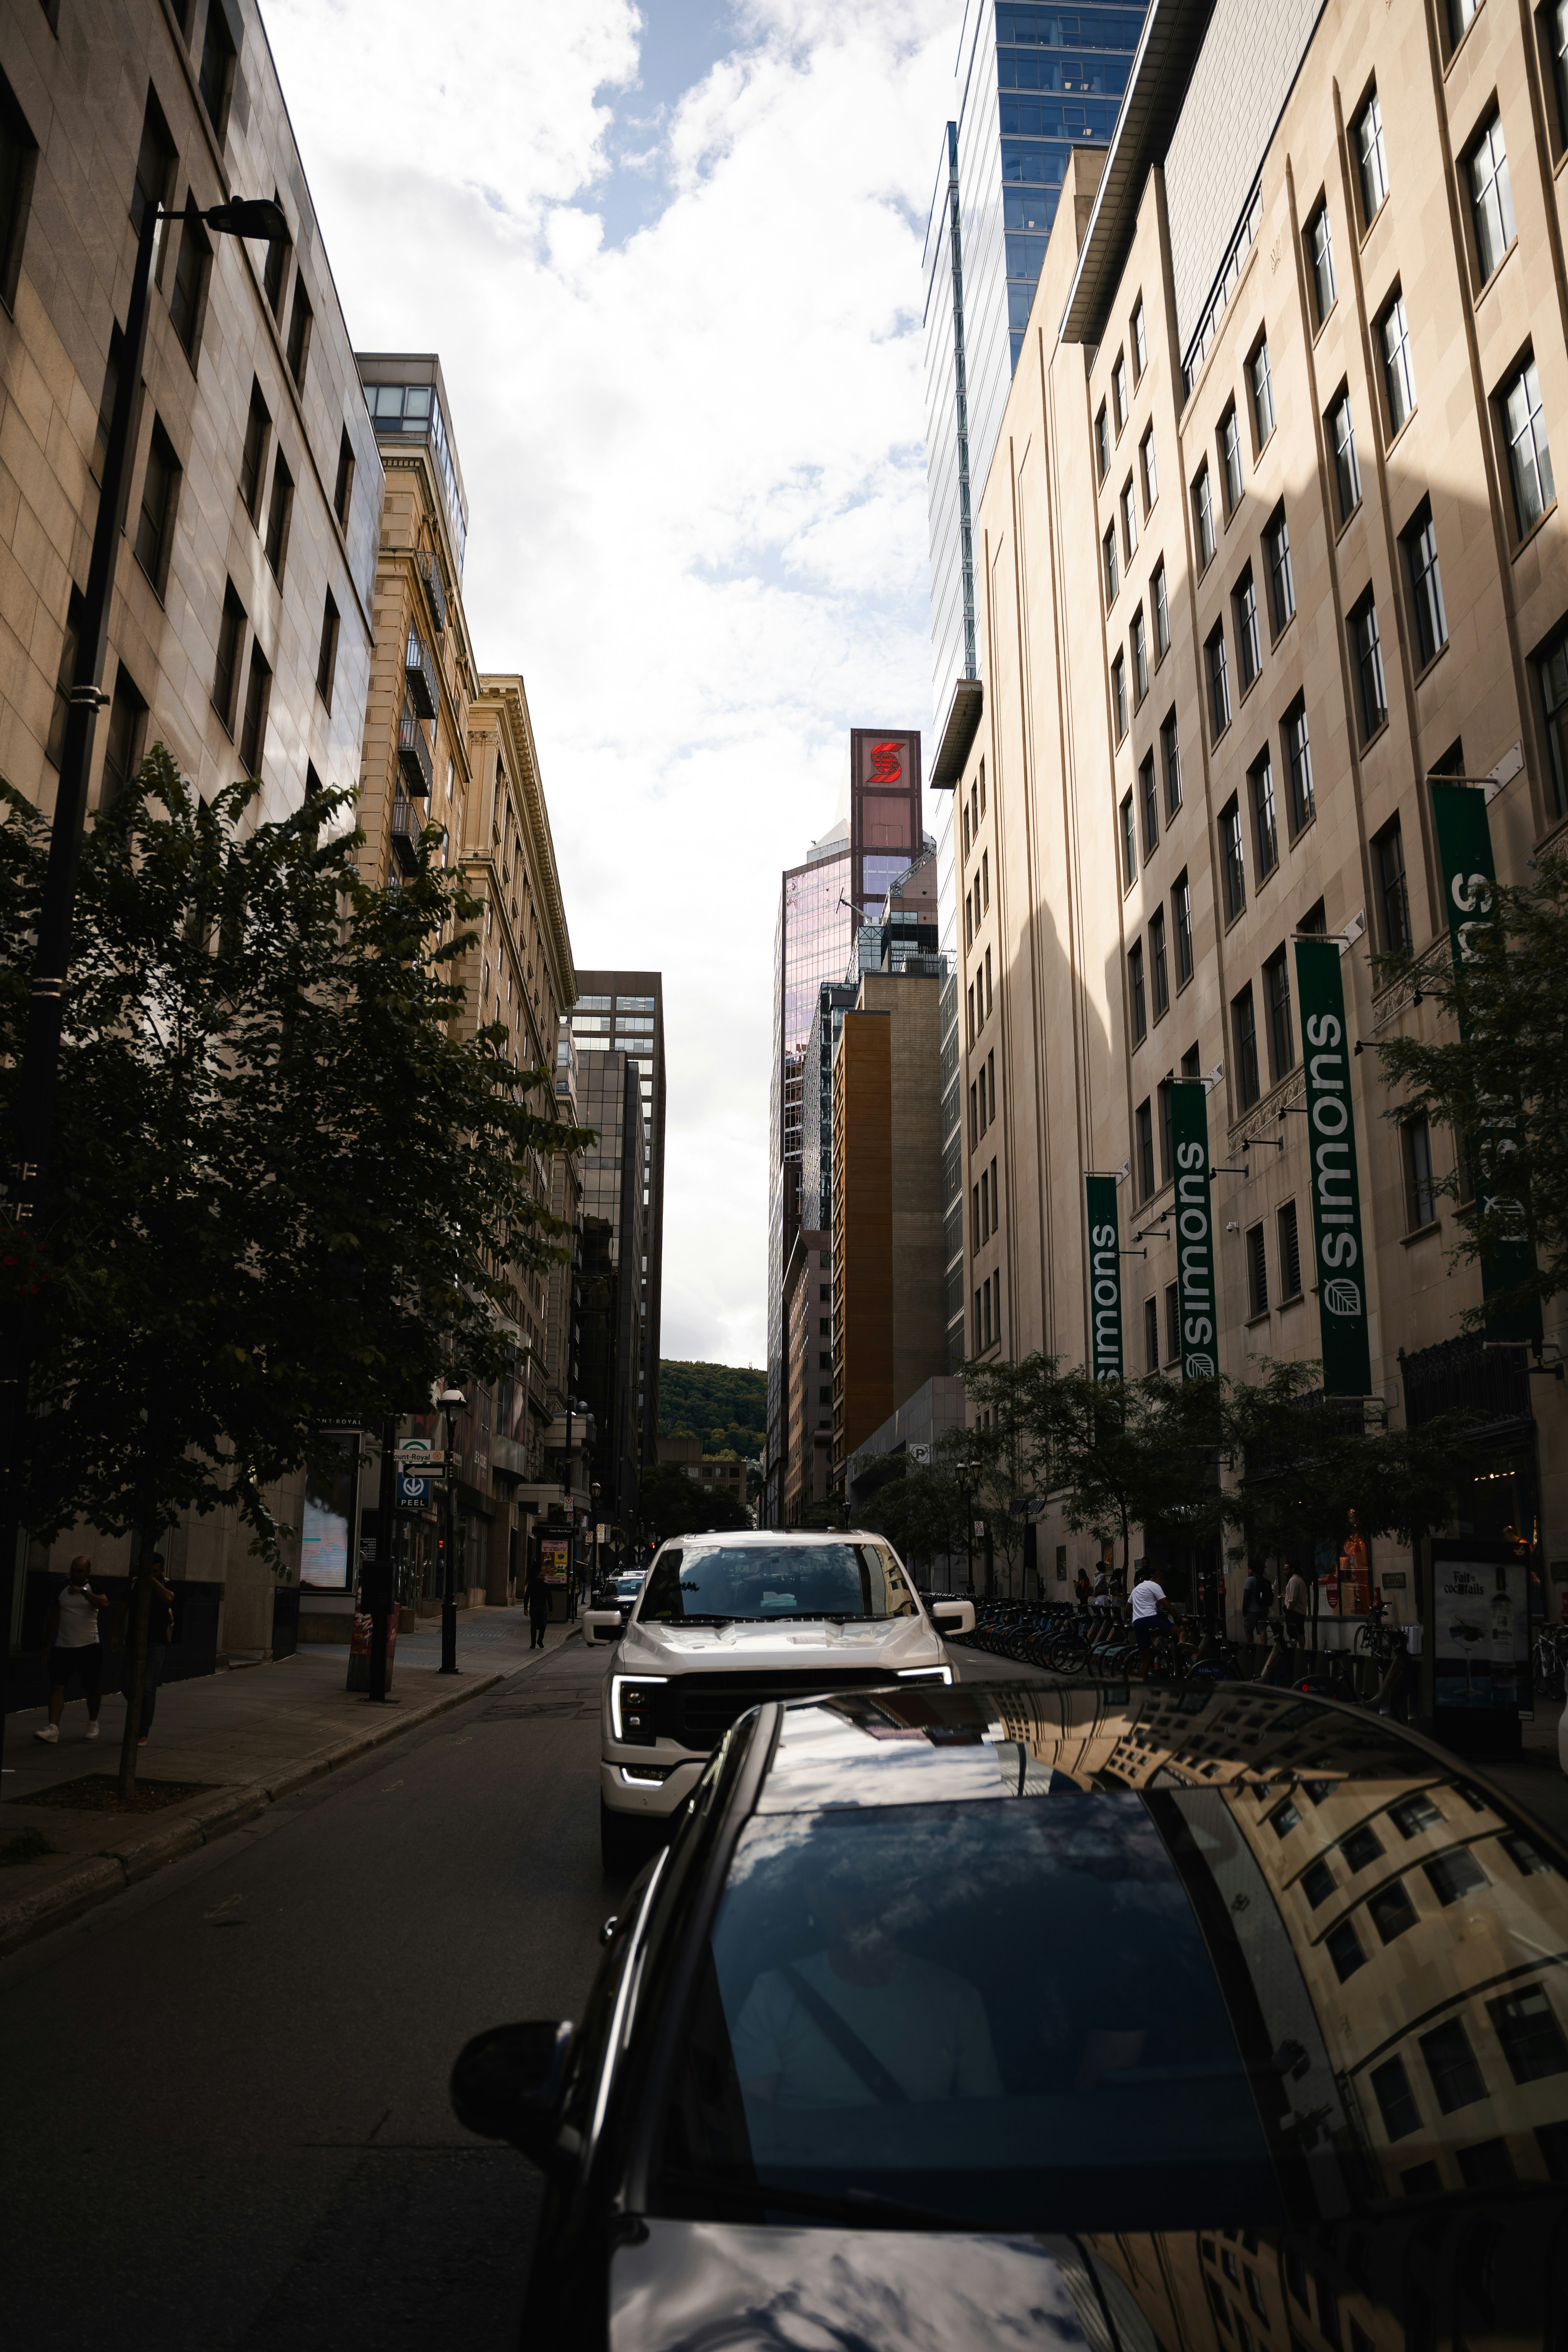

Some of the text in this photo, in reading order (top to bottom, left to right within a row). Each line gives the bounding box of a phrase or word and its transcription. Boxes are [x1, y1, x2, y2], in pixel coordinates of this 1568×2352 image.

[1451, 872, 1518, 1180] sins
[1307, 1014, 1357, 1268] simons
[1092, 1224, 1120, 1390] simons
[1177, 1142, 1213, 1344] simons
[393, 1453, 430, 1462] ount-Royal
[1453, 1571, 1470, 1584] Fait
